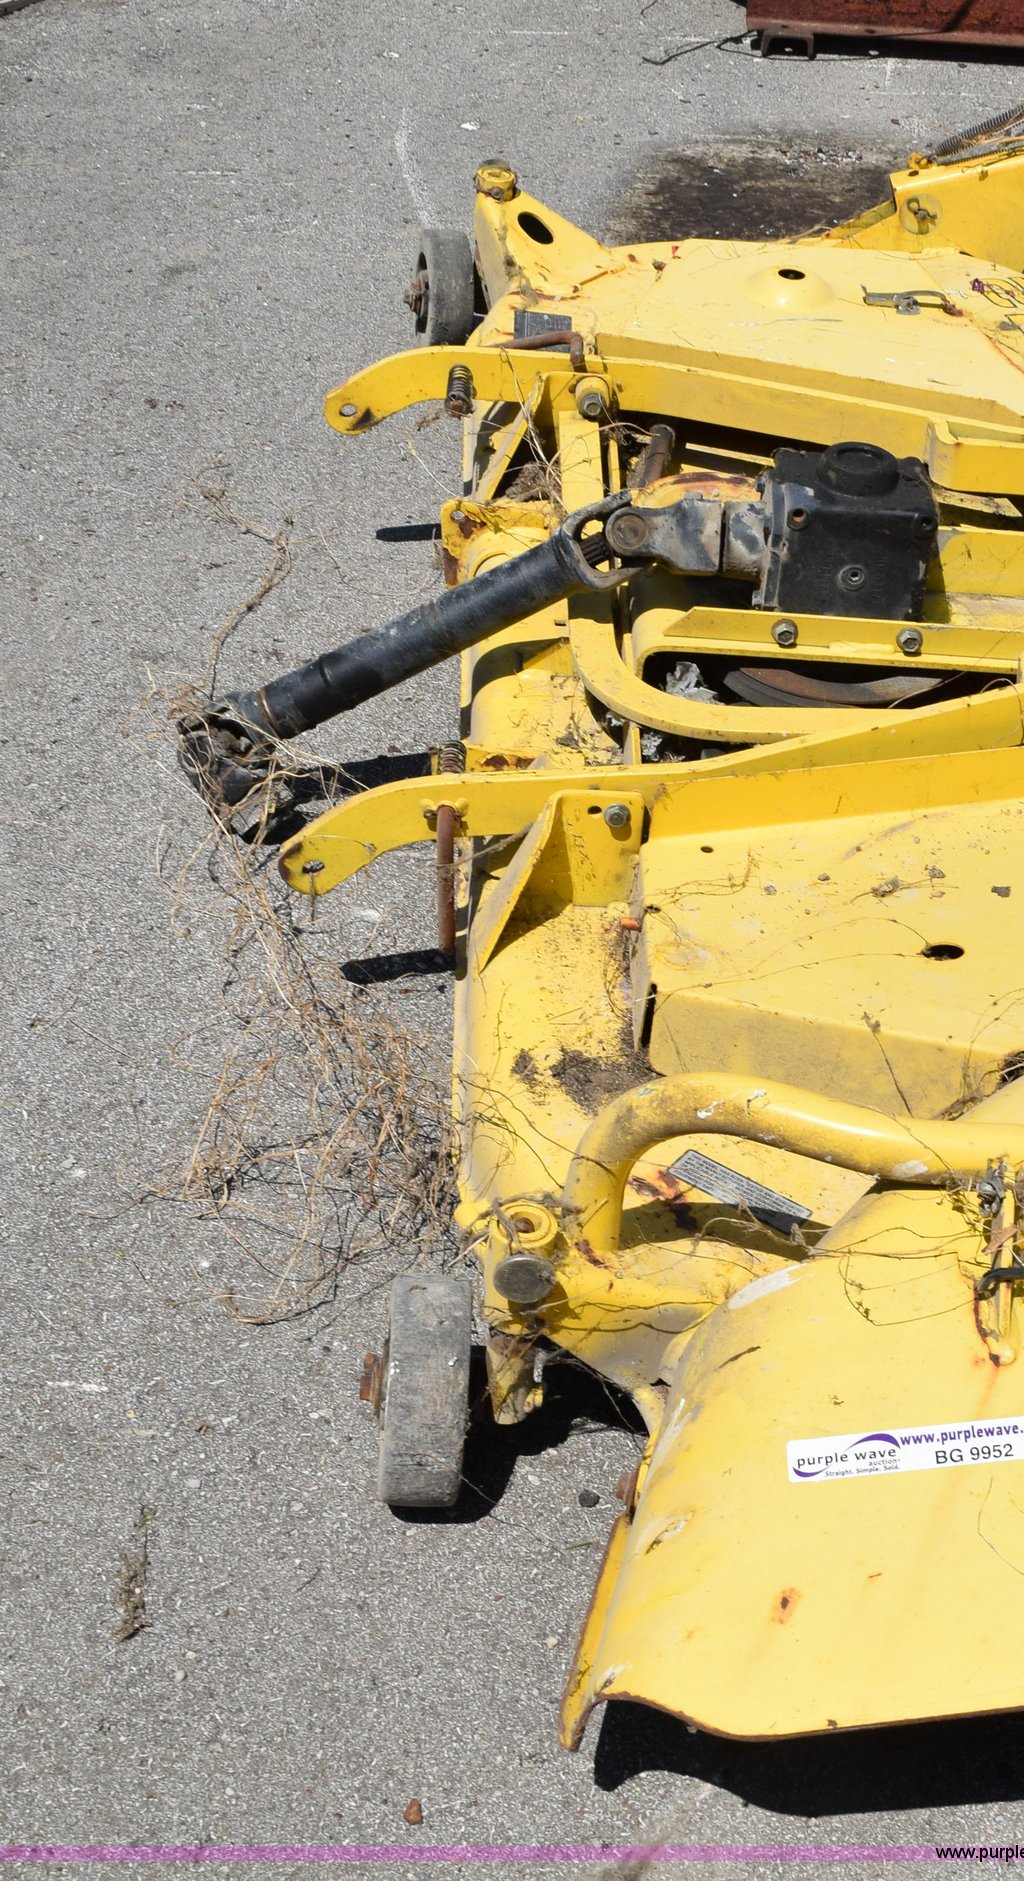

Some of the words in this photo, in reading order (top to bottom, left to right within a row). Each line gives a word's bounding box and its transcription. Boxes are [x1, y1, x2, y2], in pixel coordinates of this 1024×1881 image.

[797, 1452, 849, 1469] purple
[854, 1448, 897, 1461] wave
[935, 1448, 964, 1464] BG
[970, 1443, 1014, 1461] 9952
[825, 1468, 855, 1478] Straight.
[856, 1465, 882, 1475] Simple.
